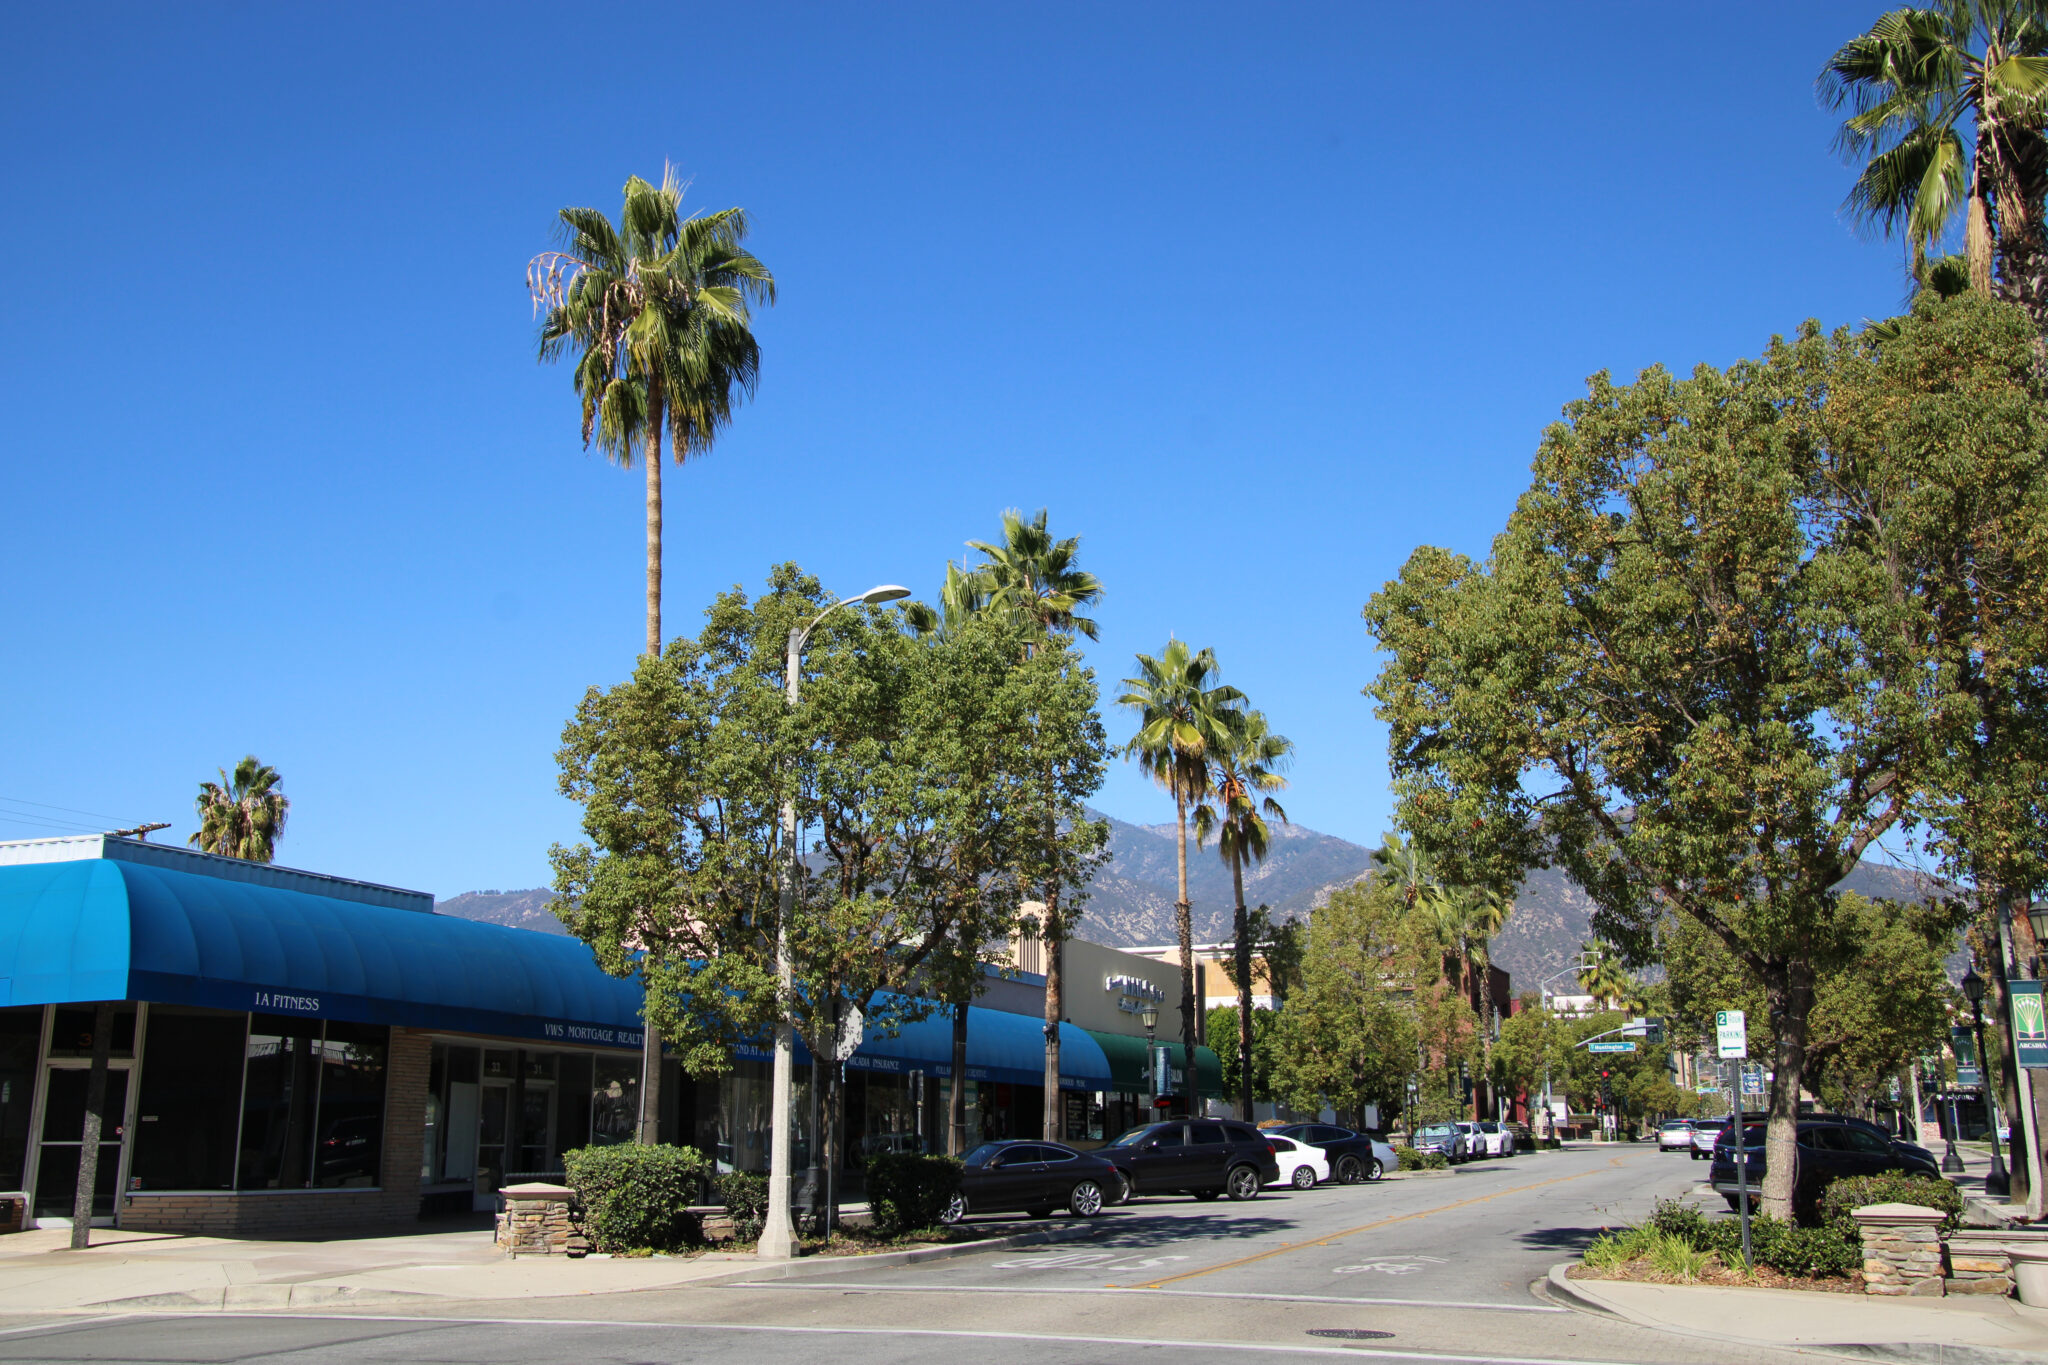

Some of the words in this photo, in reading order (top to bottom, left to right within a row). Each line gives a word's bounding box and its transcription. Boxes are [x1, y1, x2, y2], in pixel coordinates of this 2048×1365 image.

[273, 994, 320, 1011] FITNESS
[1718, 1014, 1726, 1025] 2
[1728, 1015, 1742, 1024] HOUR
[545, 1023, 564, 1037] VWS
[568, 1026, 614, 1042] MORTGAGE
[618, 1031, 644, 1045] REALTY
[1719, 1030, 1743, 1040] PARKING
[848, 1057, 870, 1068] ARCADIA
[872, 1059, 900, 1070] INSURANCE
